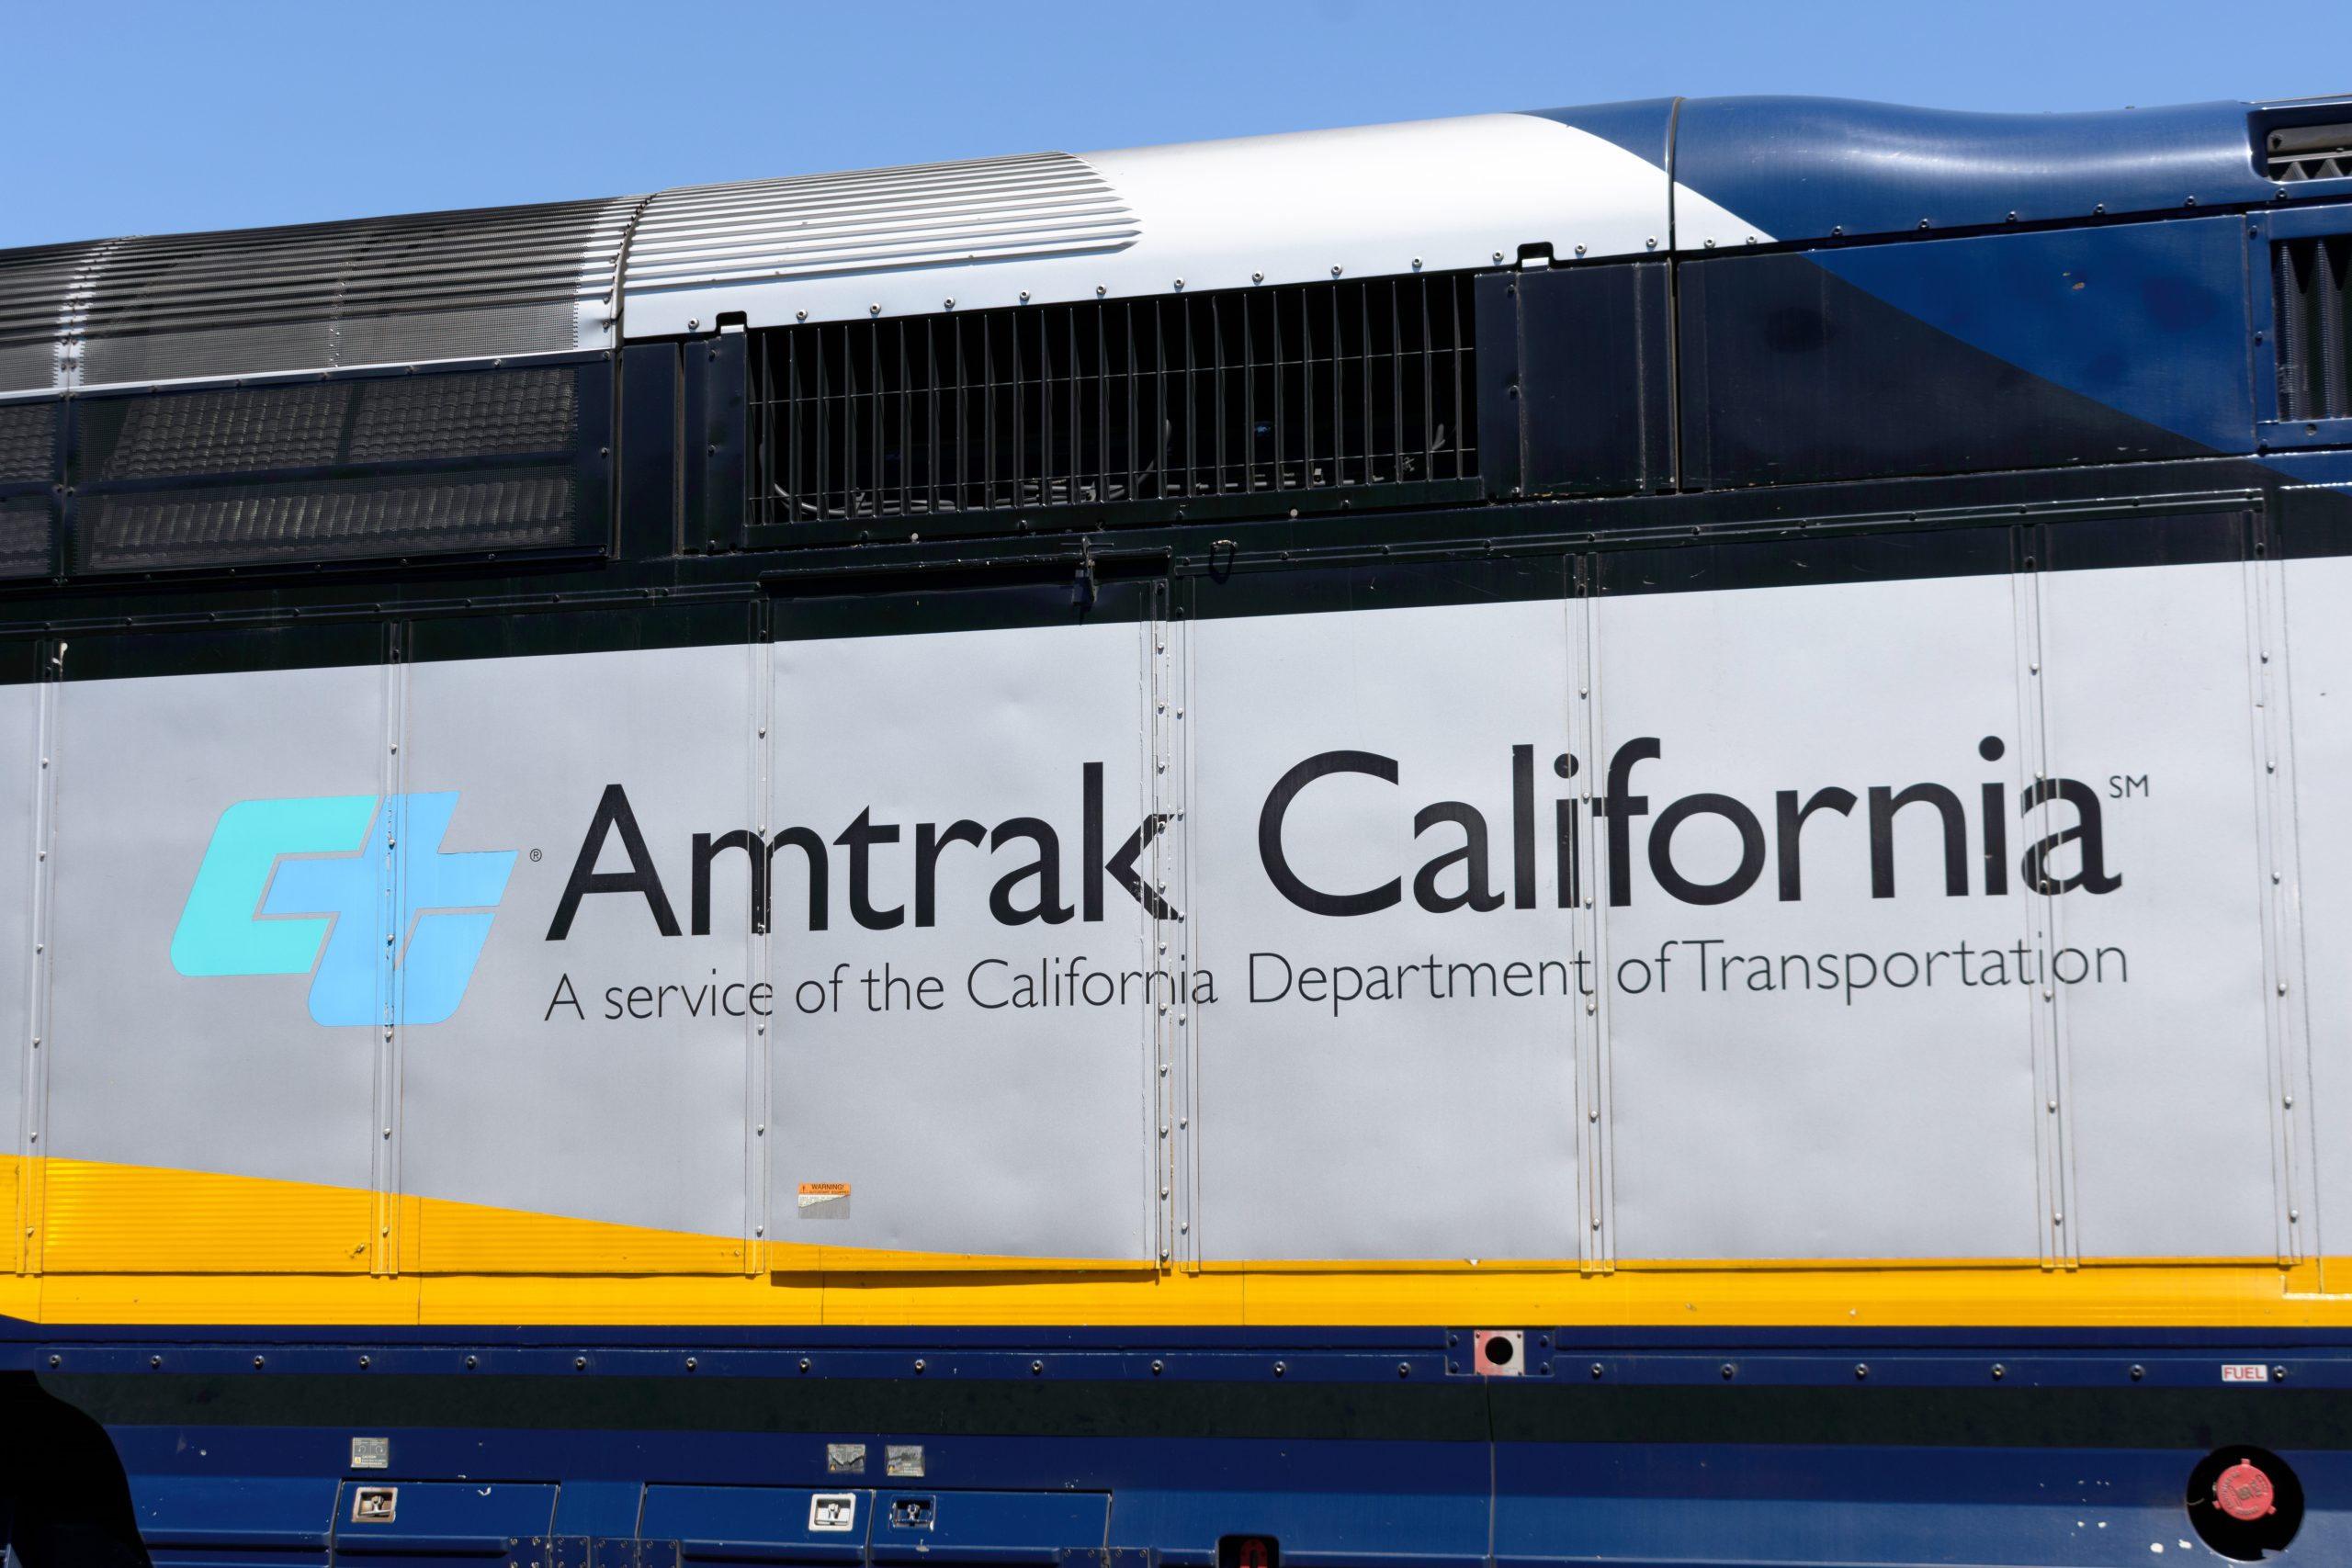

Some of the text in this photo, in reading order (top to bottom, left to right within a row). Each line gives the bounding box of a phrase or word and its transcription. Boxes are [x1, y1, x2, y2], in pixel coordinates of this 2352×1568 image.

[545, 761, 1182, 942] Amtrak
[1258, 735, 2123, 918] California
[544, 931, 2128, 1021] A service of the California Department of Transportation
[2223, 1366, 2265, 1380] FUEL
